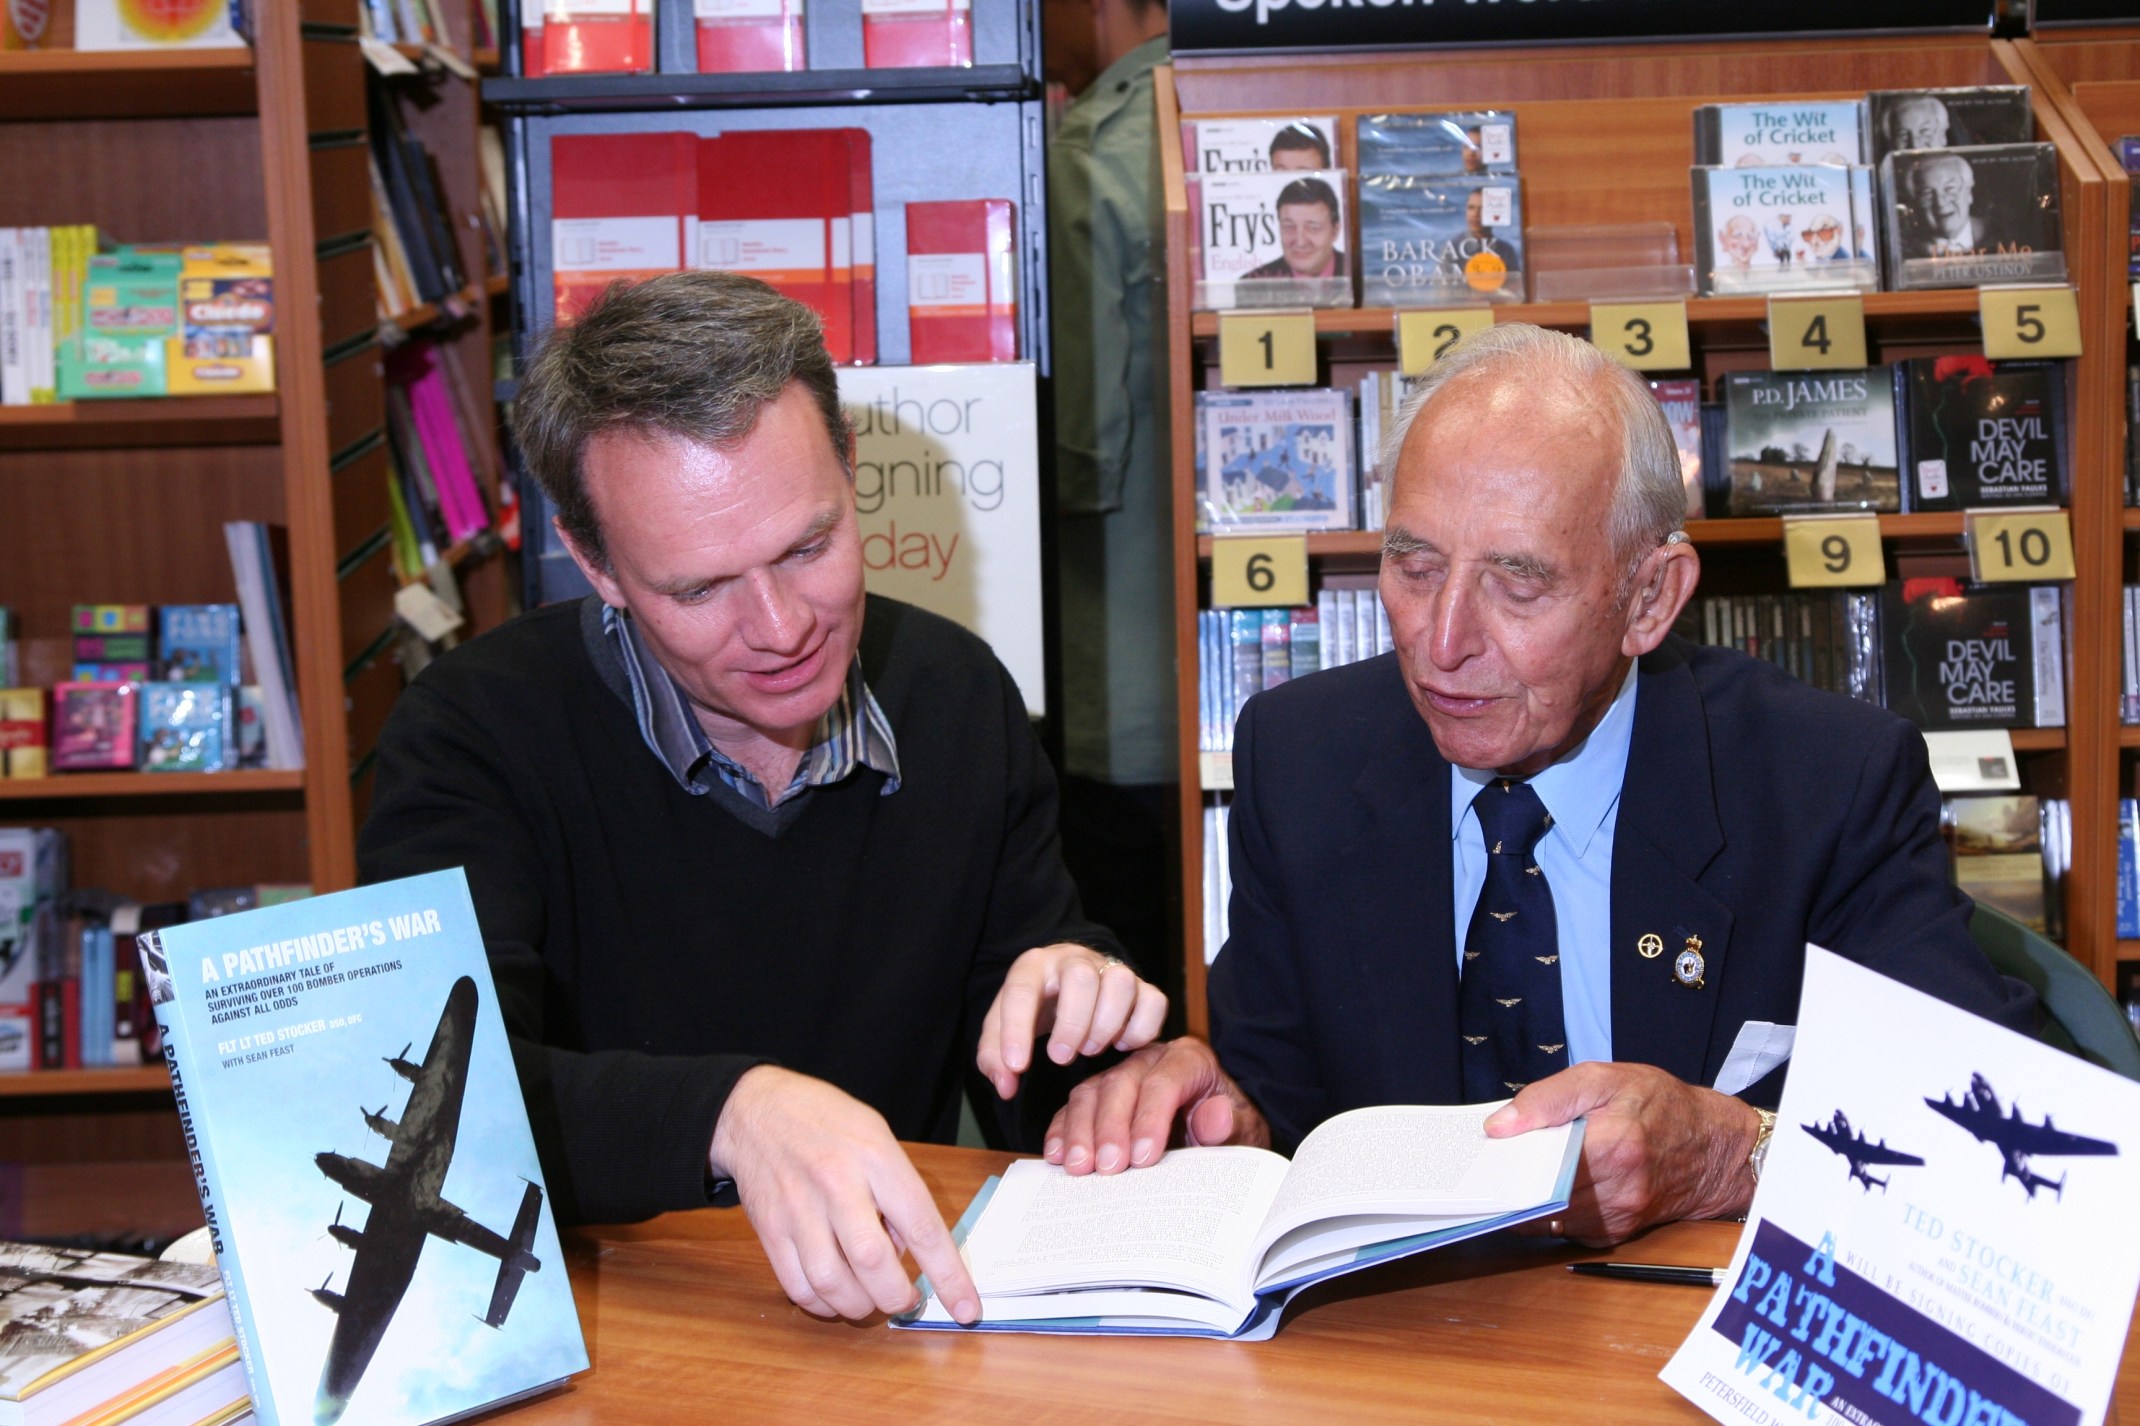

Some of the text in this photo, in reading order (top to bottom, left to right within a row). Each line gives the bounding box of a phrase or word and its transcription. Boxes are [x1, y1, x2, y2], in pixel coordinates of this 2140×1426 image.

[1744, 128, 1836, 145] of Cricket
[1752, 111, 1828, 127] The Wit
[1733, 190, 1826, 207] of Cricket
[1740, 173, 1817, 189] The Wit
[1208, 202, 1276, 254] Fry's
[1382, 238, 1500, 263] BARACK
[1432, 324, 1462, 361] 2
[1623, 318, 1655, 356] 3
[1802, 316, 1832, 355] 4
[2014, 305, 2046, 344] 5
[1257, 330, 1275, 370] 1
[854, 386, 982, 437] uthor
[1785, 378, 1868, 411] JAMES
[1217, 407, 1337, 425] Under Milk Wood
[1979, 418, 2048, 441] DEVIL
[1970, 439, 2026, 463] MAY
[855, 451, 1005, 515] gning
[1978, 459, 2047, 484] CARE
[863, 520, 960, 582] day
[1821, 534, 1852, 574] 9
[1993, 527, 2051, 568] 10
[1245, 553, 1276, 592] 6
[1947, 639, 2016, 663] DEVIL
[1939, 661, 1995, 684] MAY
[1947, 680, 2016, 705] CARE
[201, 909, 442, 984] A PATHFINDER'S WAR
[205, 962, 336, 1001] AN EXTRAORDINARY TALE OF
[207, 959, 403, 1013] SURVIVING OVER 100 BOMBER OPERATIONS
[211, 996, 299, 1026] AGAINST ALL ODDS
[217, 1038, 237, 1056] FLT
[239, 1036, 253, 1050] LT
[254, 1030, 275, 1047] TED
[276, 1018, 326, 1042] STOCKER
[348, 1013, 363, 1025] DFC
[221, 1044, 295, 1070] WITH SEAN FEAST
[158, 1023, 224, 1256] A PATHFINDER'S WAR
[1803, 1229, 1837, 1288] A
[1903, 1201, 1945, 1240] TED
[1950, 1229, 2056, 1303] STOCKER
[1845, 1249, 2073, 1395] WILL BE SIGNING COPIES OF
[1937, 1256, 2084, 1349] AND SEAN FEAST
[232, 1303, 242, 1325] TED
[237, 1326, 255, 1375] STOCKER
[1733, 1253, 2029, 1426] PATHFINDE
[1734, 1322, 1836, 1422] WAR
[1699, 1371, 1770, 1426] PETERSFIELD
[1830, 1396, 1847, 1413] AN
